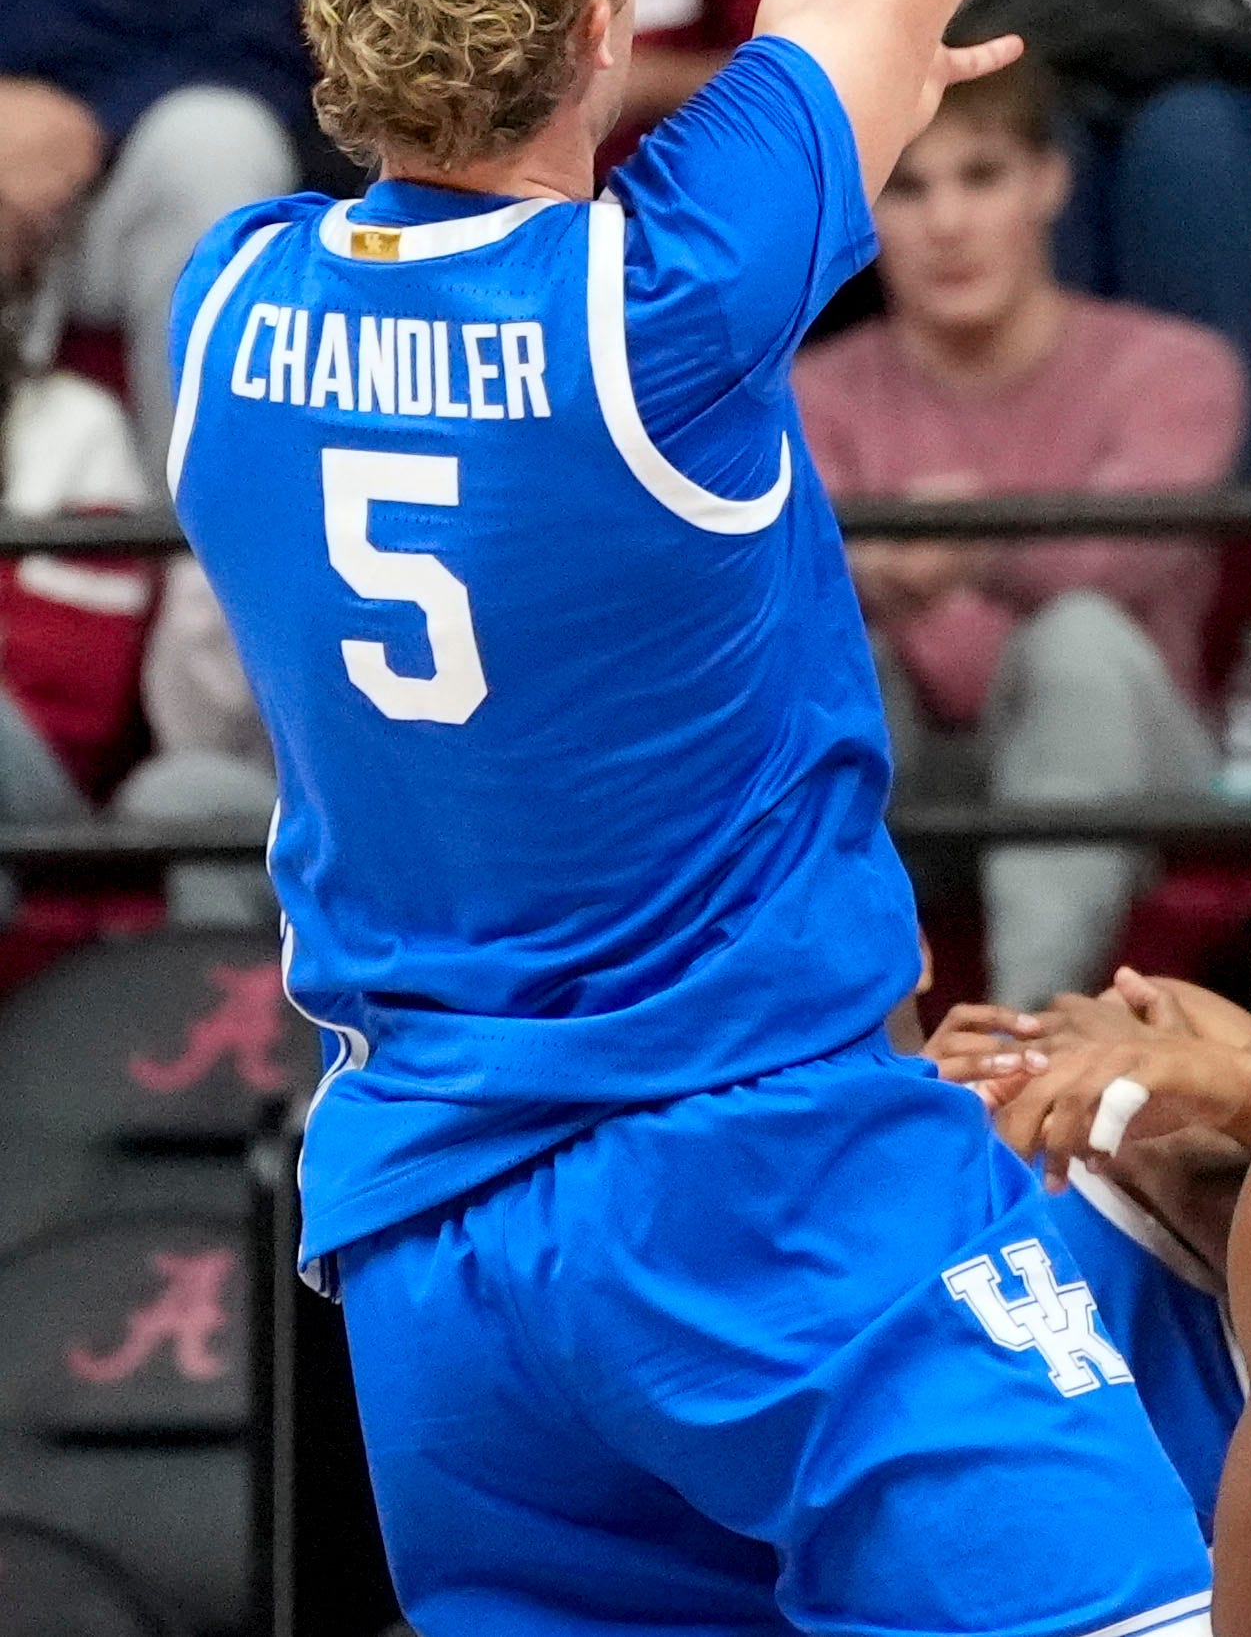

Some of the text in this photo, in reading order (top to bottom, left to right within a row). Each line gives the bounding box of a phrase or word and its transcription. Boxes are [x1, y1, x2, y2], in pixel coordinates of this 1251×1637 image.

[231, 303, 551, 420] CHANDLER
[321, 448, 488, 725] 5
[941, 1237, 1136, 1398] UK
